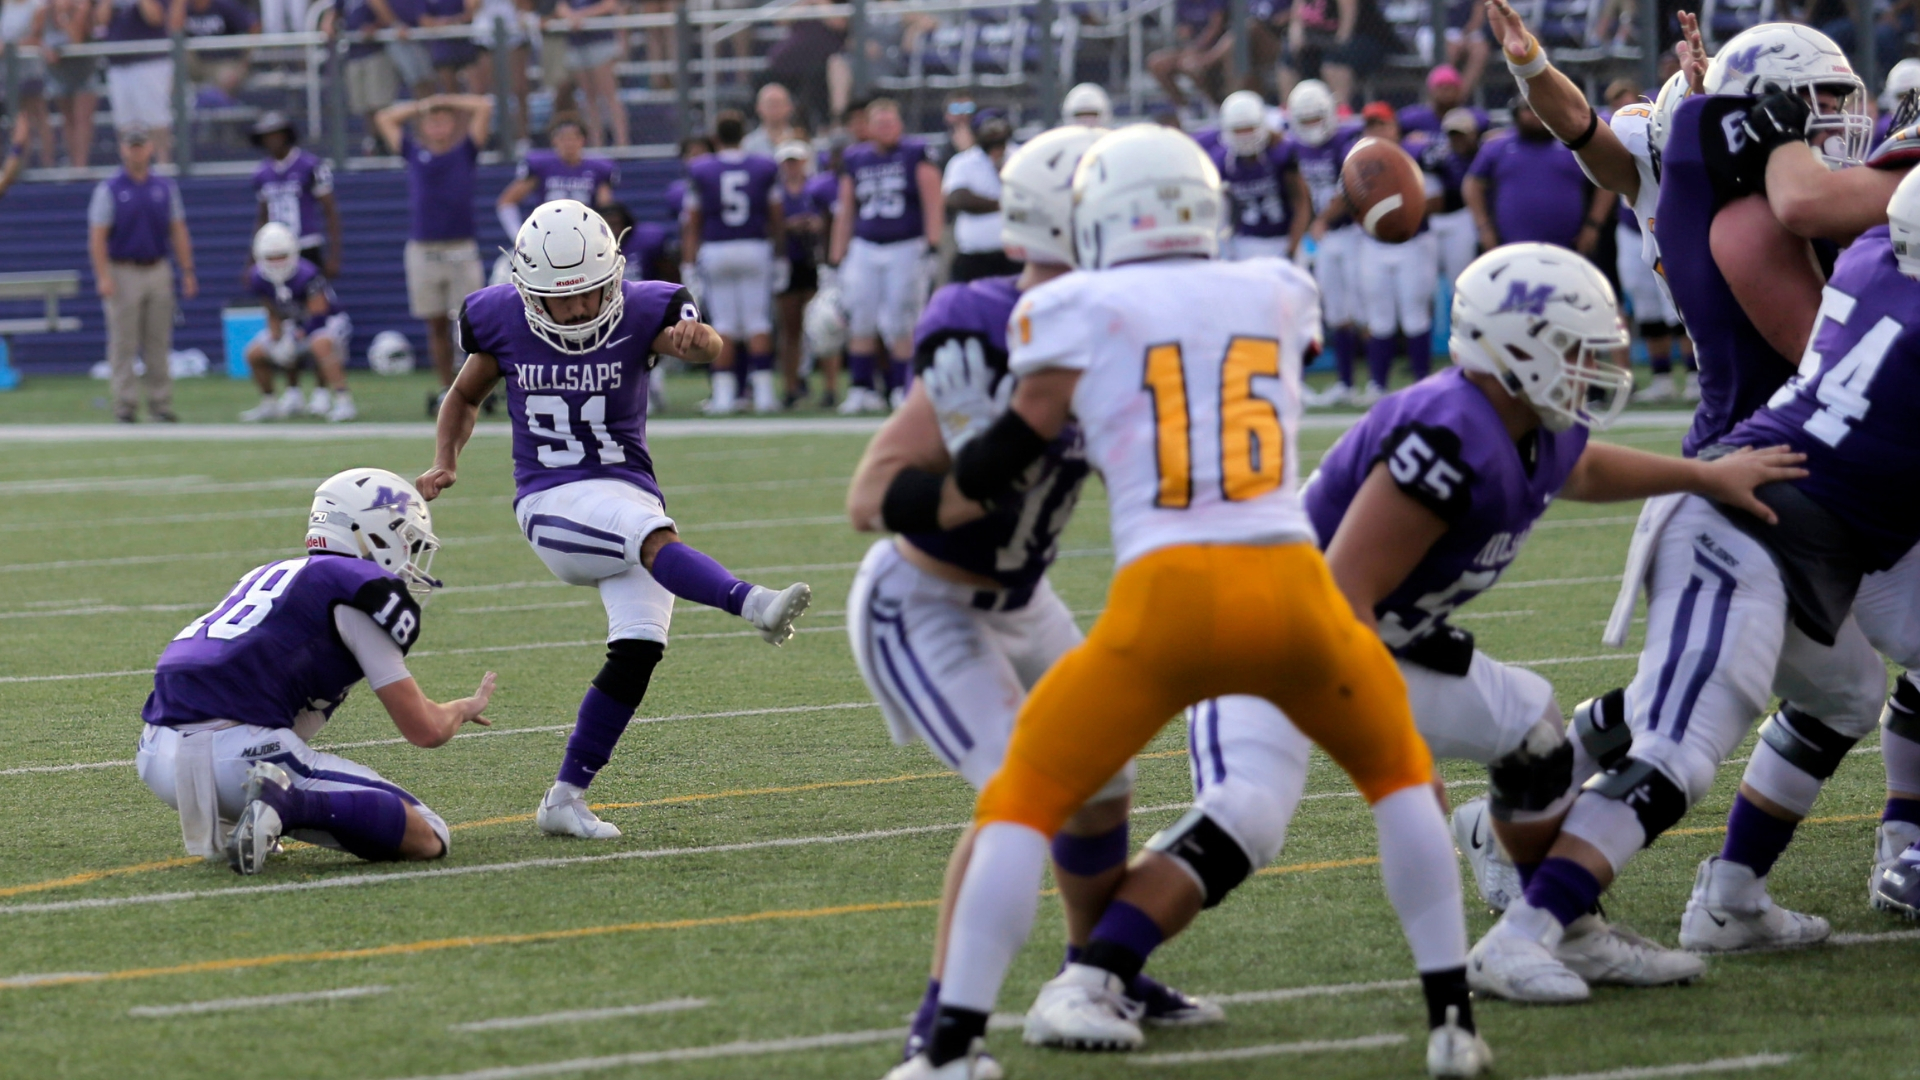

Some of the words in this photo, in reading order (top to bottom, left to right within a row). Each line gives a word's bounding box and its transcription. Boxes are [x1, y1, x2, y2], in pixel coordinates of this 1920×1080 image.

[719, 169, 751, 228] 5
[556, 276, 585, 288] Riddell
[514, 361, 623, 392] MILLSAPS
[1766, 283, 1903, 448] 54
[524, 394, 627, 469] 91
[1141, 333, 1285, 509] 16
[1388, 431, 1464, 501] 55
[172, 556, 312, 641] 18
[372, 592, 417, 646] 18
[240, 741, 281, 758] MAJORS
